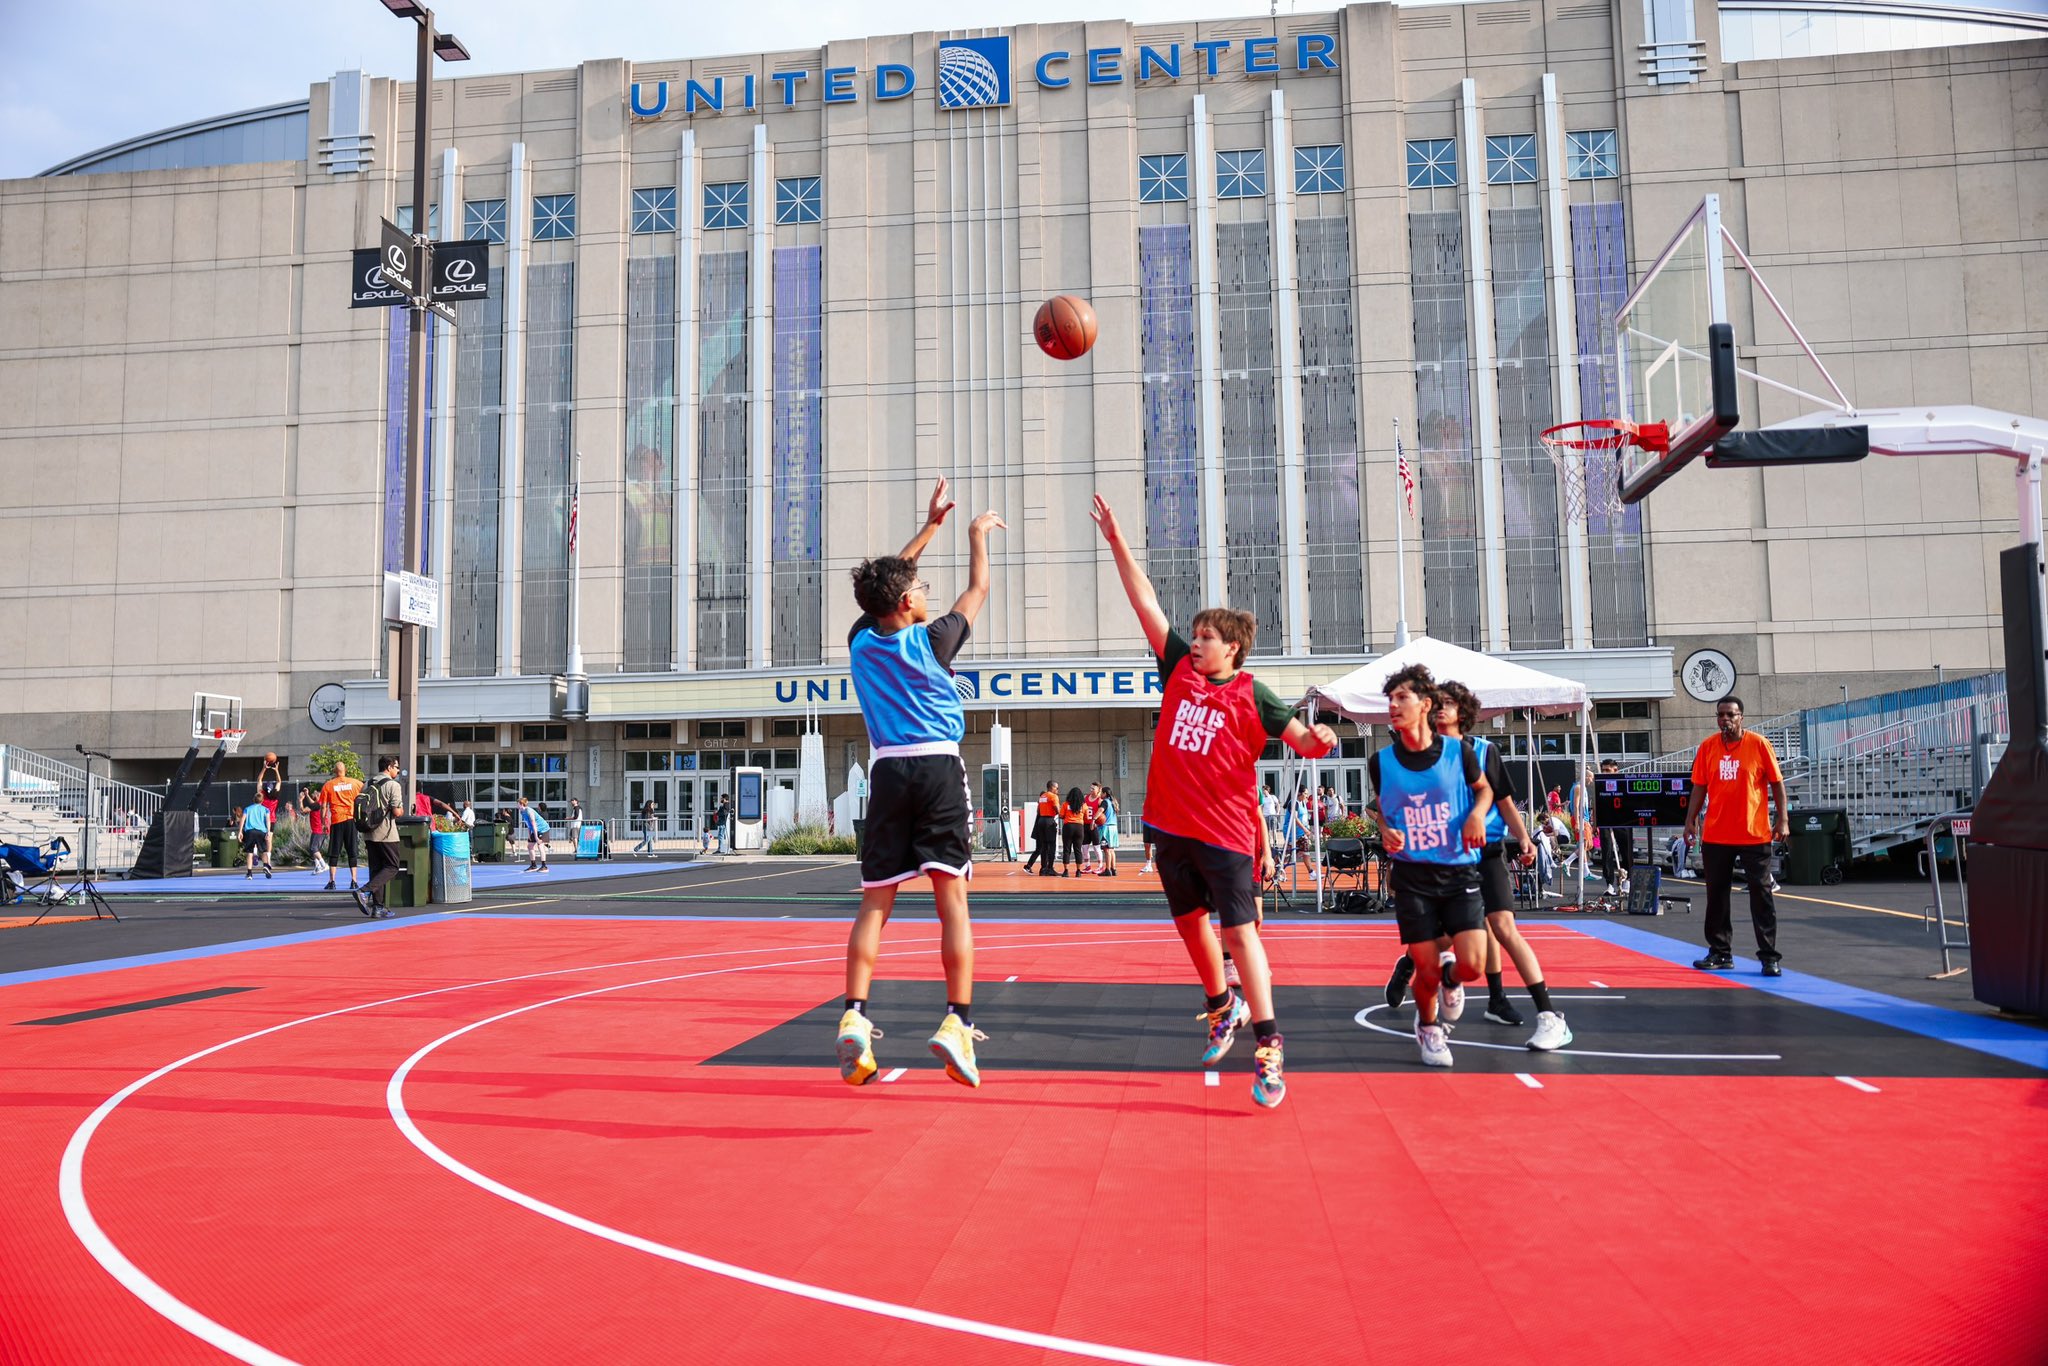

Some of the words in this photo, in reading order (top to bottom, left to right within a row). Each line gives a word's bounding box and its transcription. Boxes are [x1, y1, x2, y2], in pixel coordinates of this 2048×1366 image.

[630, 63, 917, 118] UNITED
[1034, 33, 1339, 89] CENTER
[381, 262, 413, 290] LEXUS
[353, 289, 406, 301] LEXUS
[433, 283, 487, 295] LEXUS
[426, 293, 456, 318] LXUS
[775, 679, 848, 703] UNI
[990, 671, 1164, 697] CENTER
[1175, 699, 1226, 733] BULLS
[703, 738, 729, 748] GATE
[732, 738, 738, 748] 7
[1169, 720, 1216, 756] FEST
[1719, 759, 1740, 770] BULLS
[1719, 768, 1738, 781] FEST
[1633, 780, 1660, 791] 10:00
[1613, 797, 1621, 809] 0
[1679, 796, 1687, 808] 0
[1403, 801, 1451, 828] BULLS
[1639, 817, 1645, 826] 0
[1651, 817, 1657, 826] 0
[1407, 823, 1449, 851] FEST
